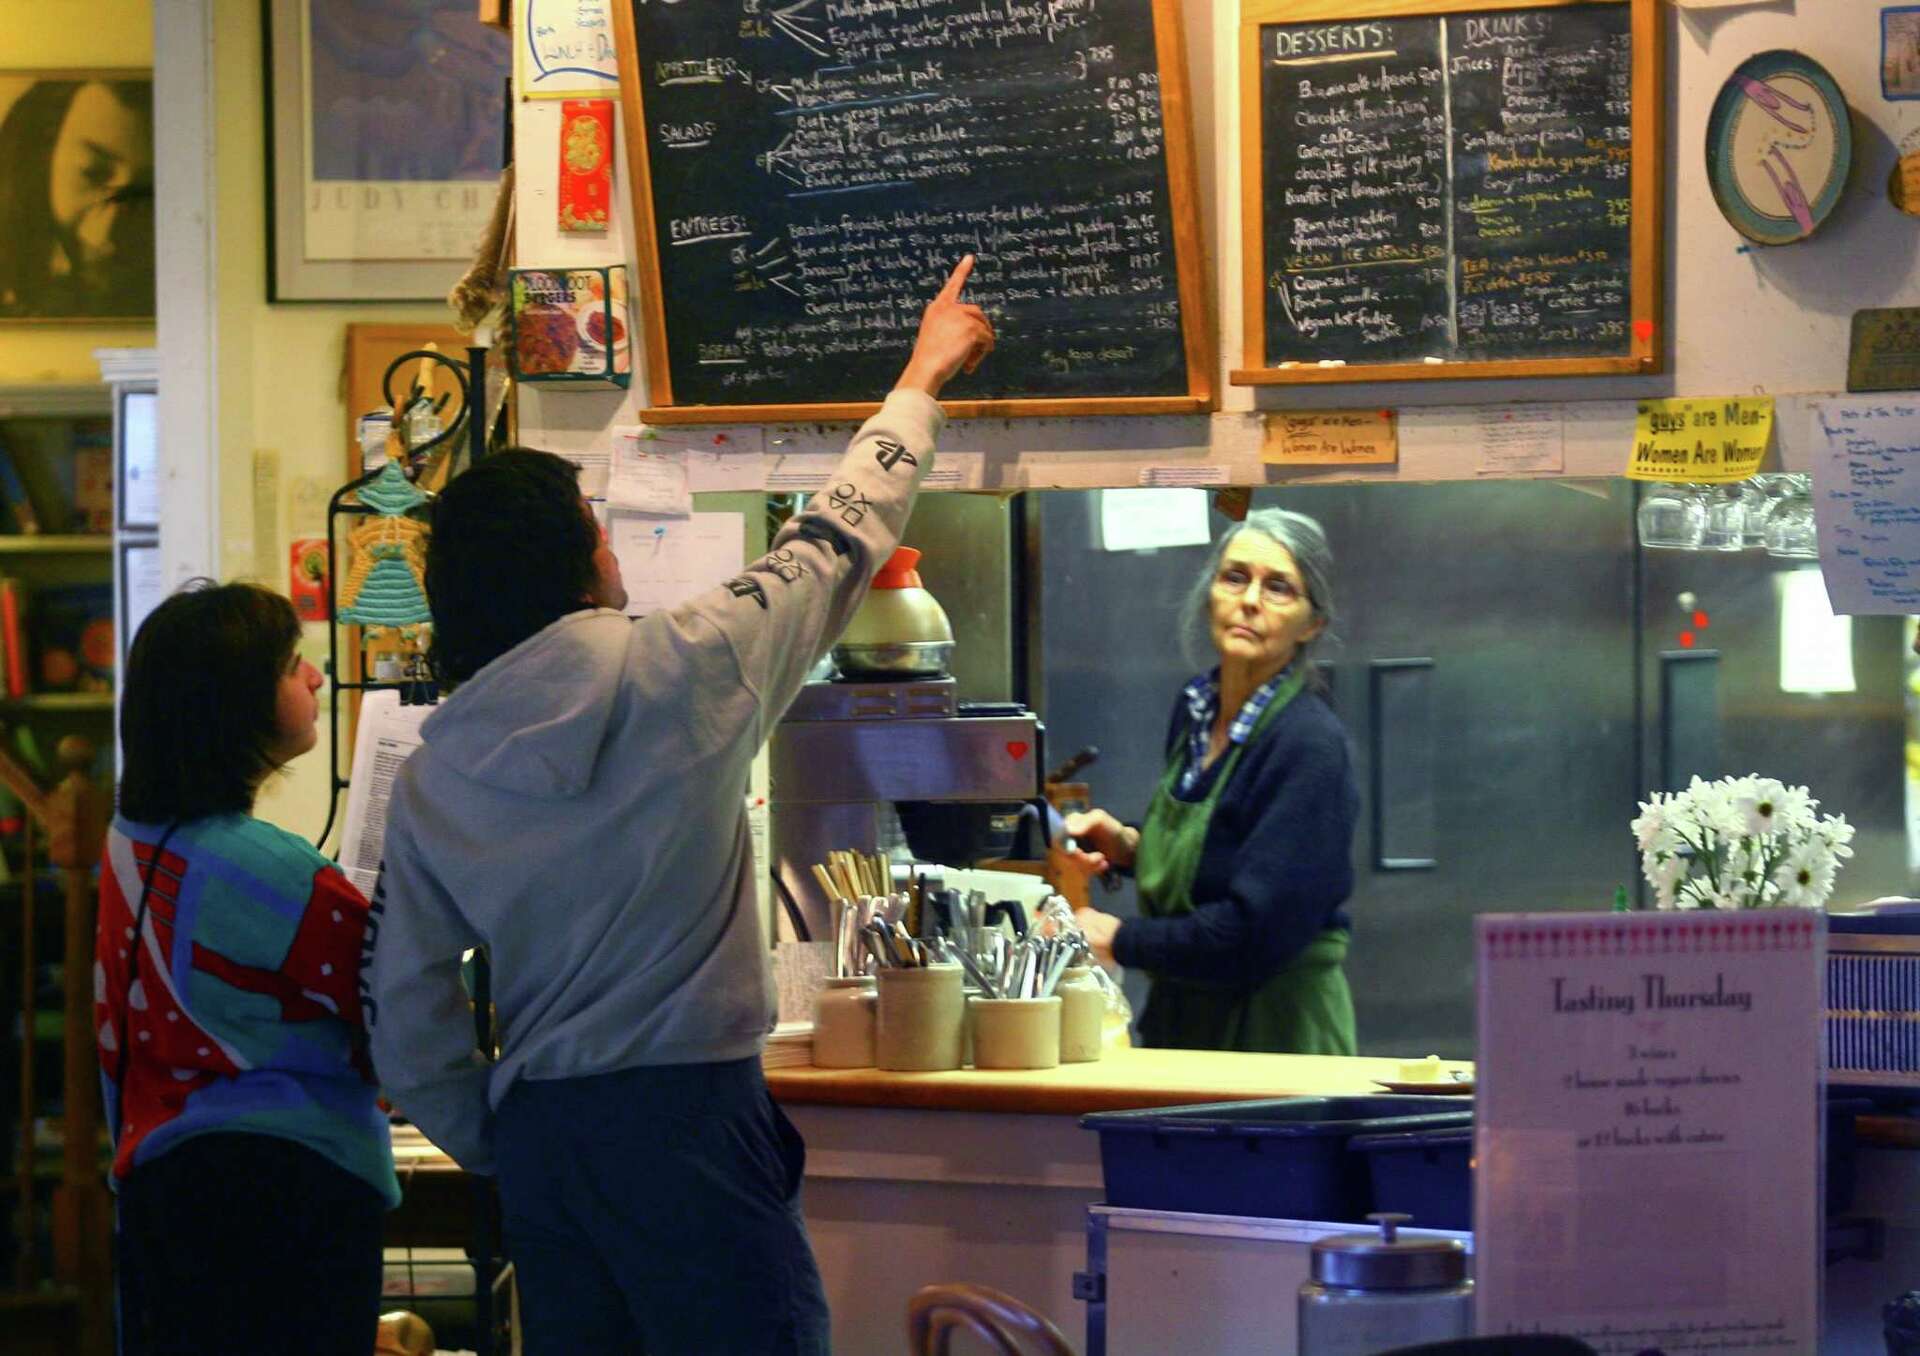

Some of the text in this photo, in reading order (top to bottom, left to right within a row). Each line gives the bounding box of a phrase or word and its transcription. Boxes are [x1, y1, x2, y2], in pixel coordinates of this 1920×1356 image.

[1276, 23, 1393, 56] DESSERTS:
[1637, 442, 1690, 465] Women
[1693, 440, 1718, 464] Are
[1550, 973, 1753, 1015] Tasting Thursday
